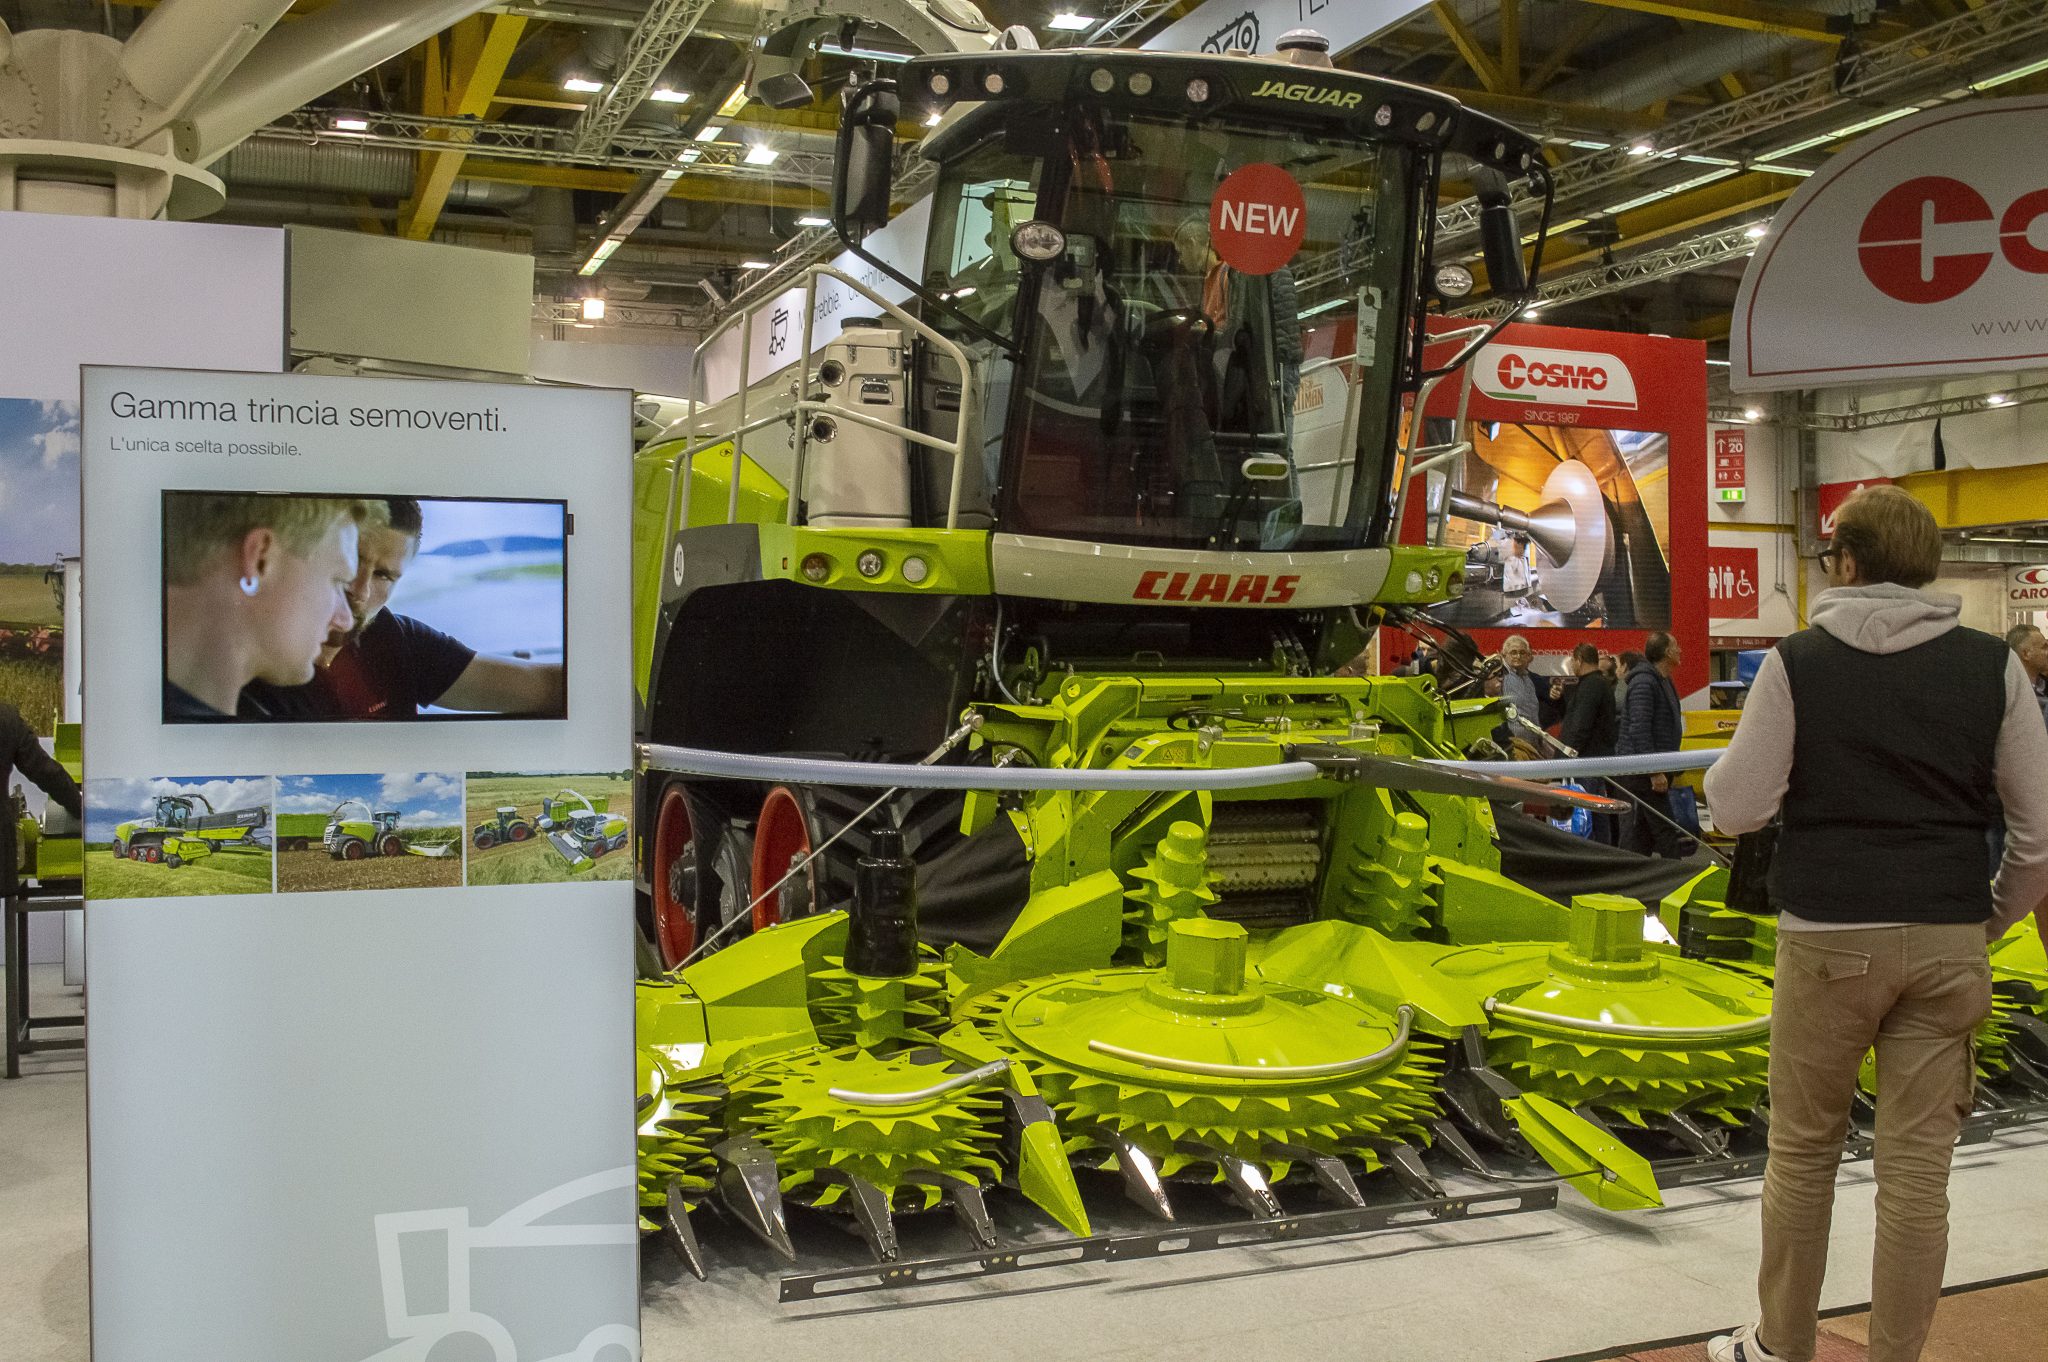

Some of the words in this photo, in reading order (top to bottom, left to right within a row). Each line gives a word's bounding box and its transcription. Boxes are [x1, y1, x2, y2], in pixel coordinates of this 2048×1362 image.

[1251, 80, 1363, 109] JAGUAR
[1219, 199, 1300, 237] NEW
[1497, 353, 1607, 391] COSMO
[109, 391, 237, 422] Gamma
[247, 398, 339, 427] trincia
[349, 405, 508, 433] semoventi.
[1524, 409, 1557, 422] SINCE
[1558, 411, 1581, 424] 1987
[109, 436, 171, 453] L'unica
[175, 439, 223, 455] scelta
[228, 441, 303, 458] possibile.
[1728, 443, 1744, 453] 20
[1132, 570, 1301, 604] CLAAS
